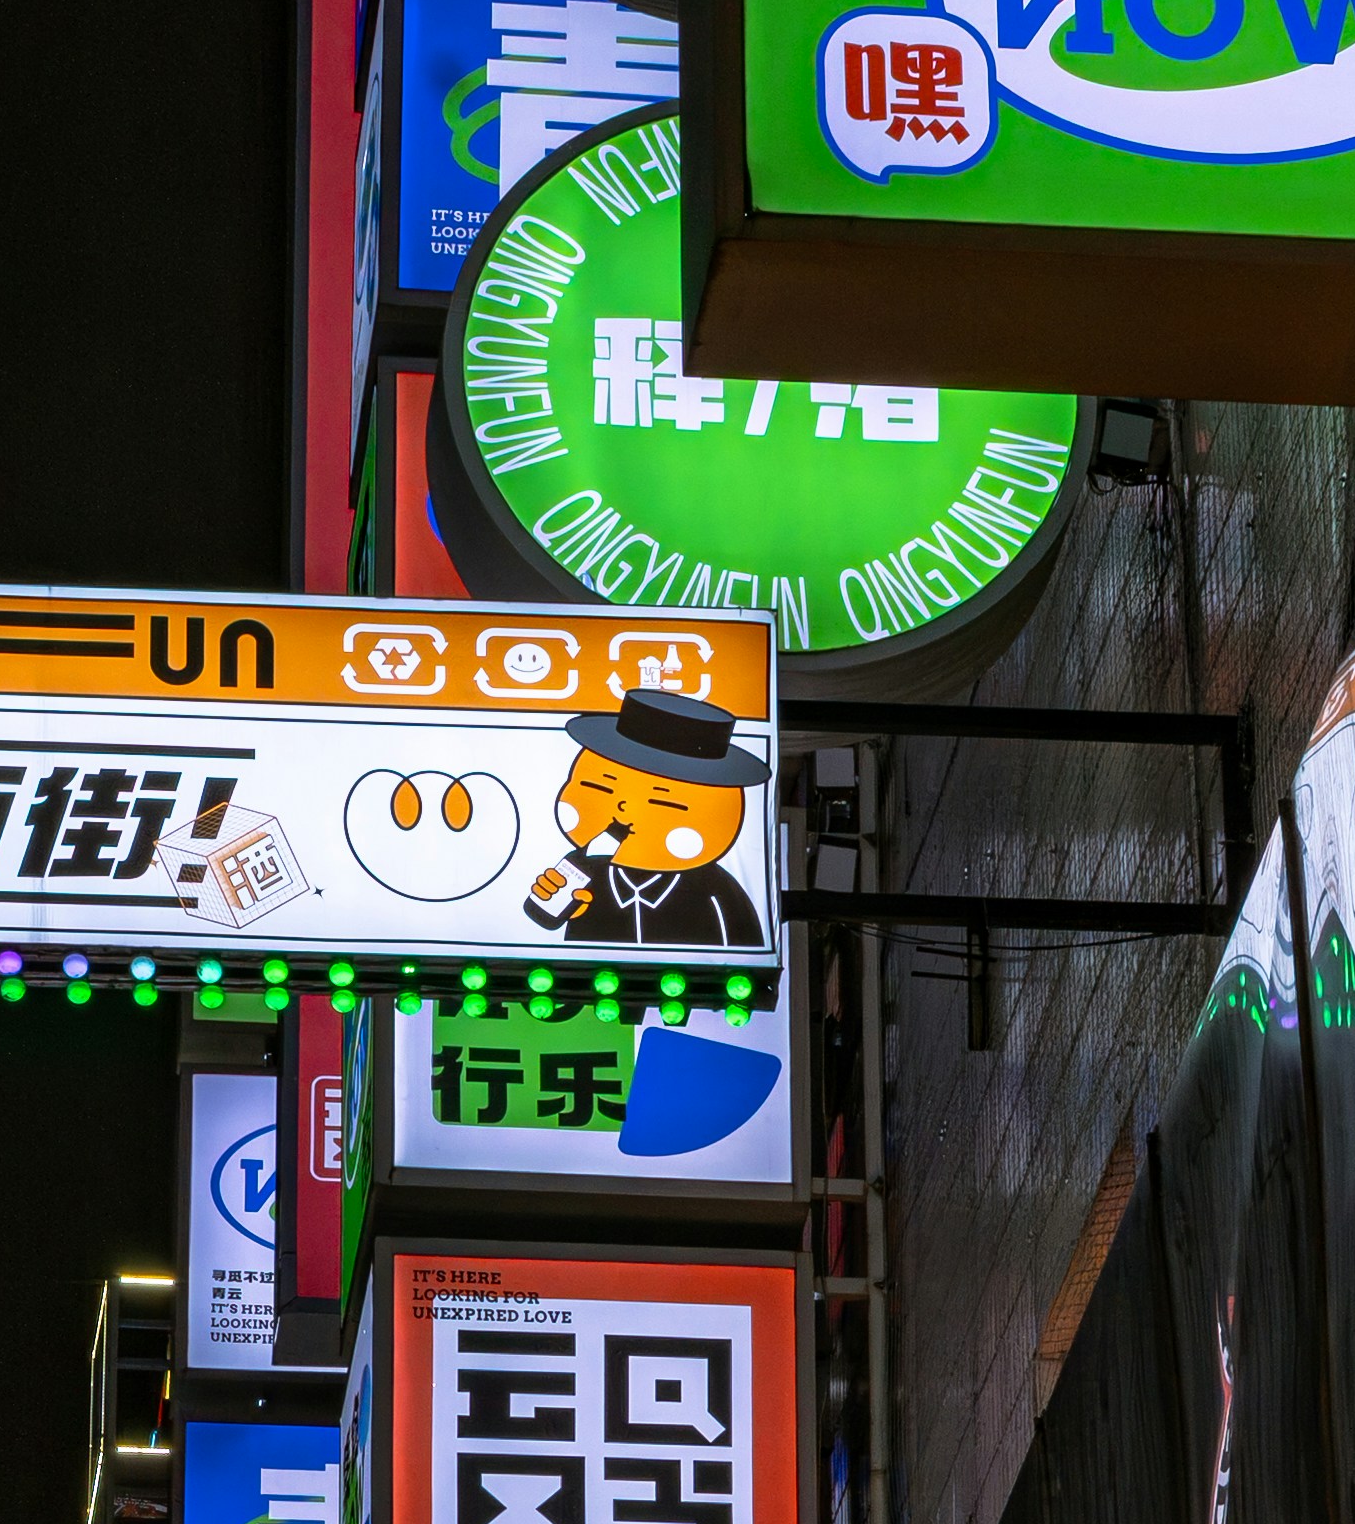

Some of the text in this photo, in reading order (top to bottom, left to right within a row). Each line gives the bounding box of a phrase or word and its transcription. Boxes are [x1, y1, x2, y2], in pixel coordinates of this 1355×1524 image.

[843, 42, 966, 146] 嘿
[465, 212, 587, 476] QINGYUNFUN
[839, 427, 1069, 642] QINGYUNFUN
[431, 1043, 629, 1128] 行乐
[412, 1269, 502, 1285] IT'S HERE
[412, 1287, 540, 1305] LOOKING FOR
[211, 1302, 238, 1314] IT'S
[412, 1306, 573, 1324] UNEXPIRED LOVE
